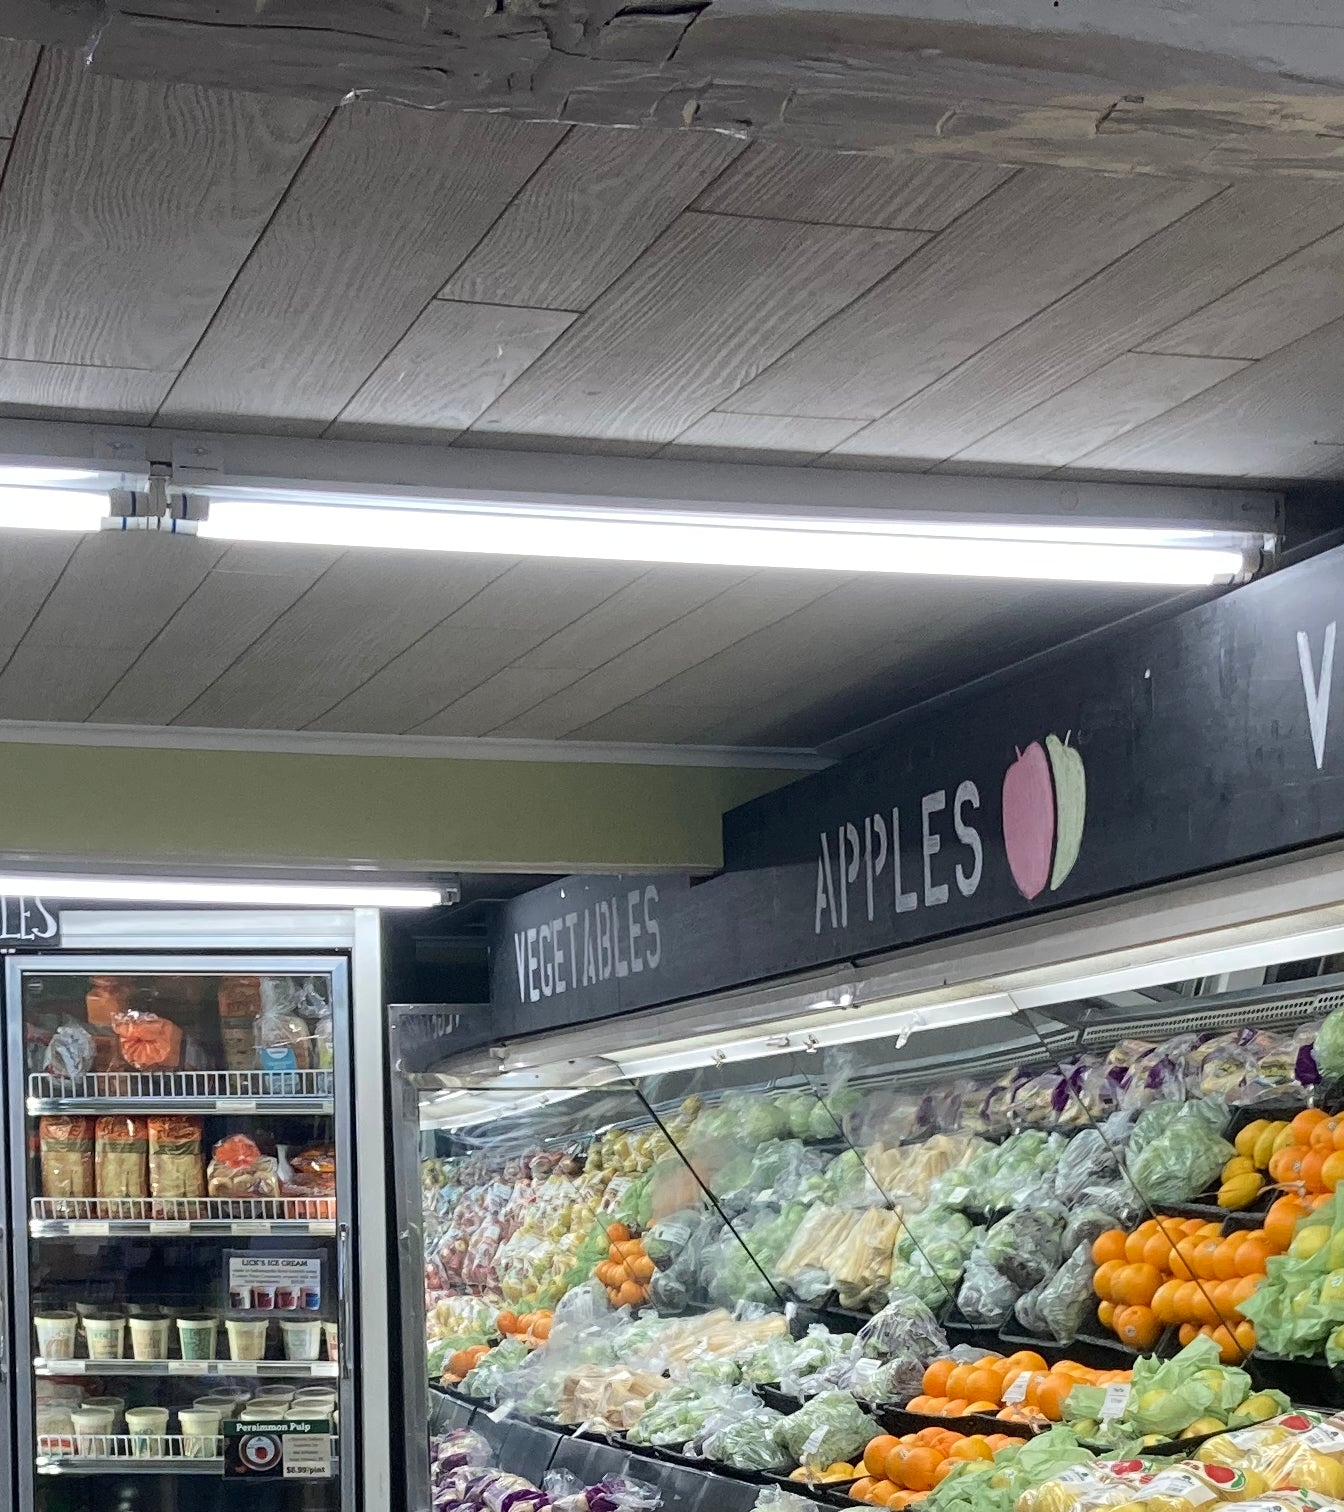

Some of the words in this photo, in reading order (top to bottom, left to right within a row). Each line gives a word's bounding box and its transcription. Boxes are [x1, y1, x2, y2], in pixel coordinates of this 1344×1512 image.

[814, 780, 985, 934] APPLES
[514, 884, 663, 1004] VEGETABLES
[235, 1422, 288, 1432] Persimmon
[290, 1422, 311, 1433] Pulp
